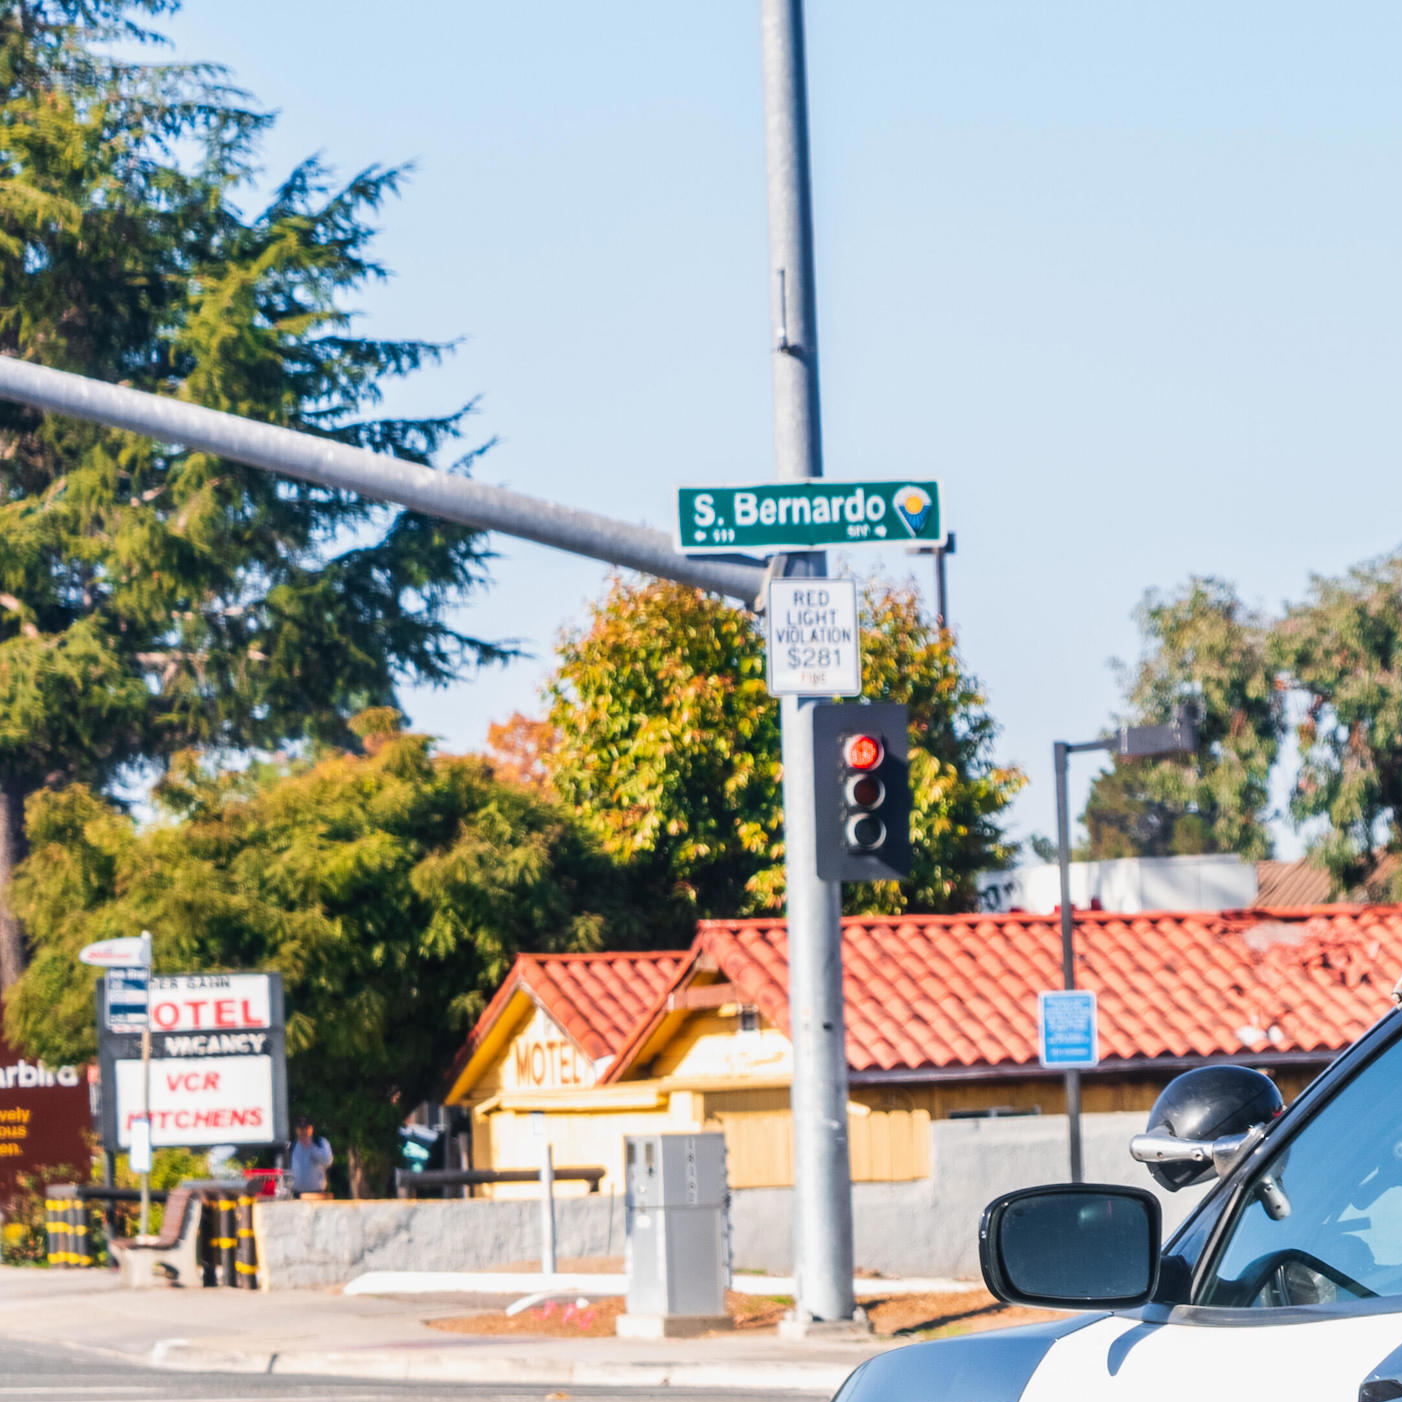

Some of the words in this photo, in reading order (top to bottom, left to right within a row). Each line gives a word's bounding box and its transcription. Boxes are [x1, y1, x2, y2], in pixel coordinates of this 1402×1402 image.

[694, 493, 724, 526] S.
[734, 487, 886, 526] Bernardo
[793, 589, 830, 607] RED
[786, 609, 837, 627] LIGHT
[776, 627, 851, 643] VIOLATION
[787, 645, 841, 668] $281
[152, 999, 264, 1032] OTEL
[164, 1032, 267, 1056] VACANCY
[516, 1041, 581, 1085] MOTEL
[165, 1071, 220, 1092] VCR
